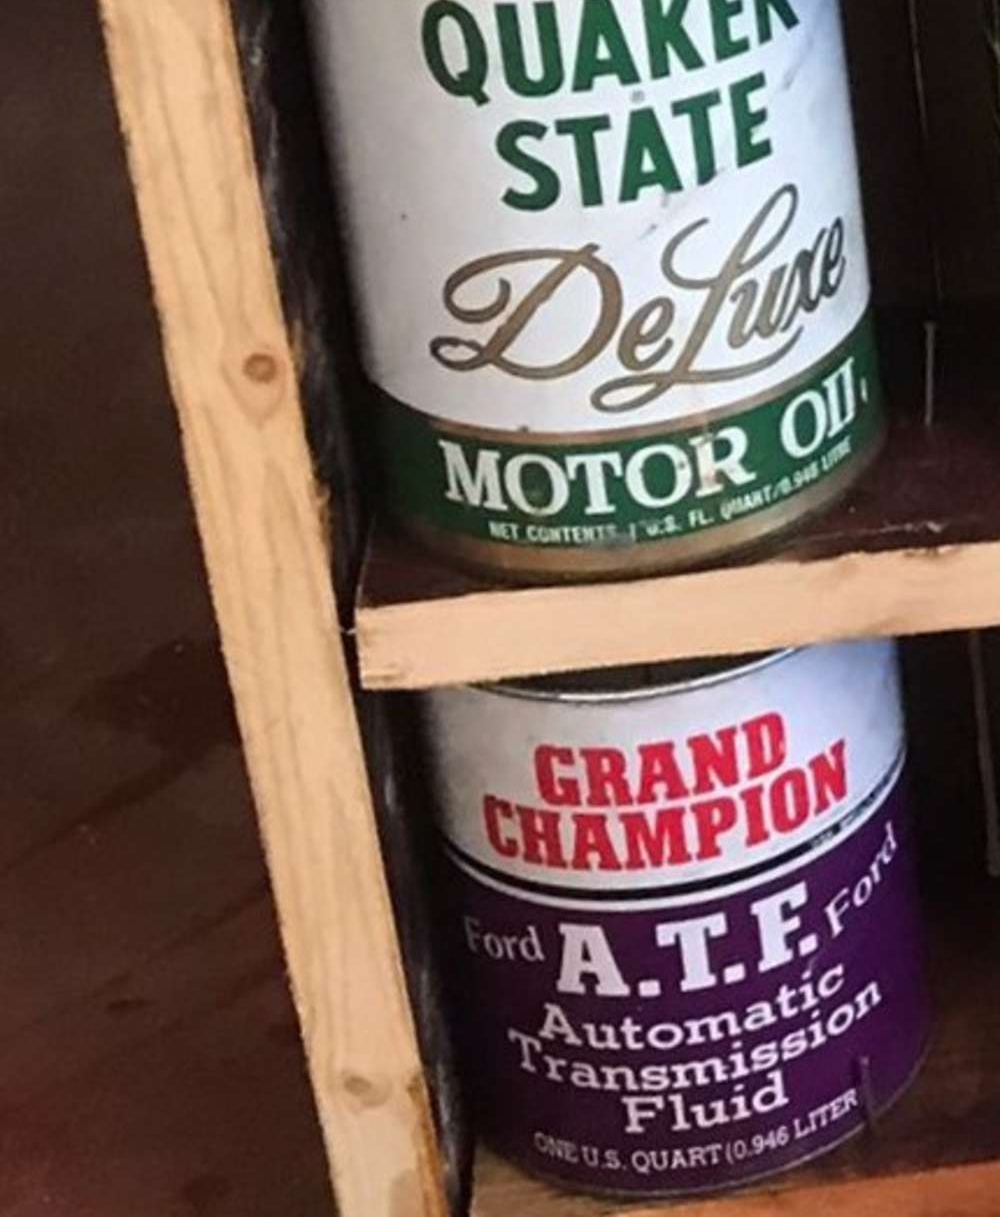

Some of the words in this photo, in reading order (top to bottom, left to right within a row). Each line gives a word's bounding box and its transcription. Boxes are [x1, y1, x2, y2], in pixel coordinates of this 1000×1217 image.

[496, 71, 773, 212] STATE
[430, 183, 847, 413] DeLuxe
[438, 425, 756, 517] MOTOR
[488, 520, 518, 541] NET
[689, 508, 716, 530] FL.
[482, 738, 849, 872] CHAMPION
[533, 710, 787, 808] GRAND
[464, 915, 547, 963] Ford
[556, 882, 819, 997] A.T.F.
[823, 820, 899, 938] Ford
[507, 980, 884, 1093] Transmission
[538, 964, 846, 1051] Automatic
[533, 1131, 580, 1163] ONE
[581, 1147, 628, 1171] U.S.
[634, 1144, 723, 1173] QUART
[725, 1126, 790, 1166] (0.946
[622, 1069, 790, 1135] Fluid
